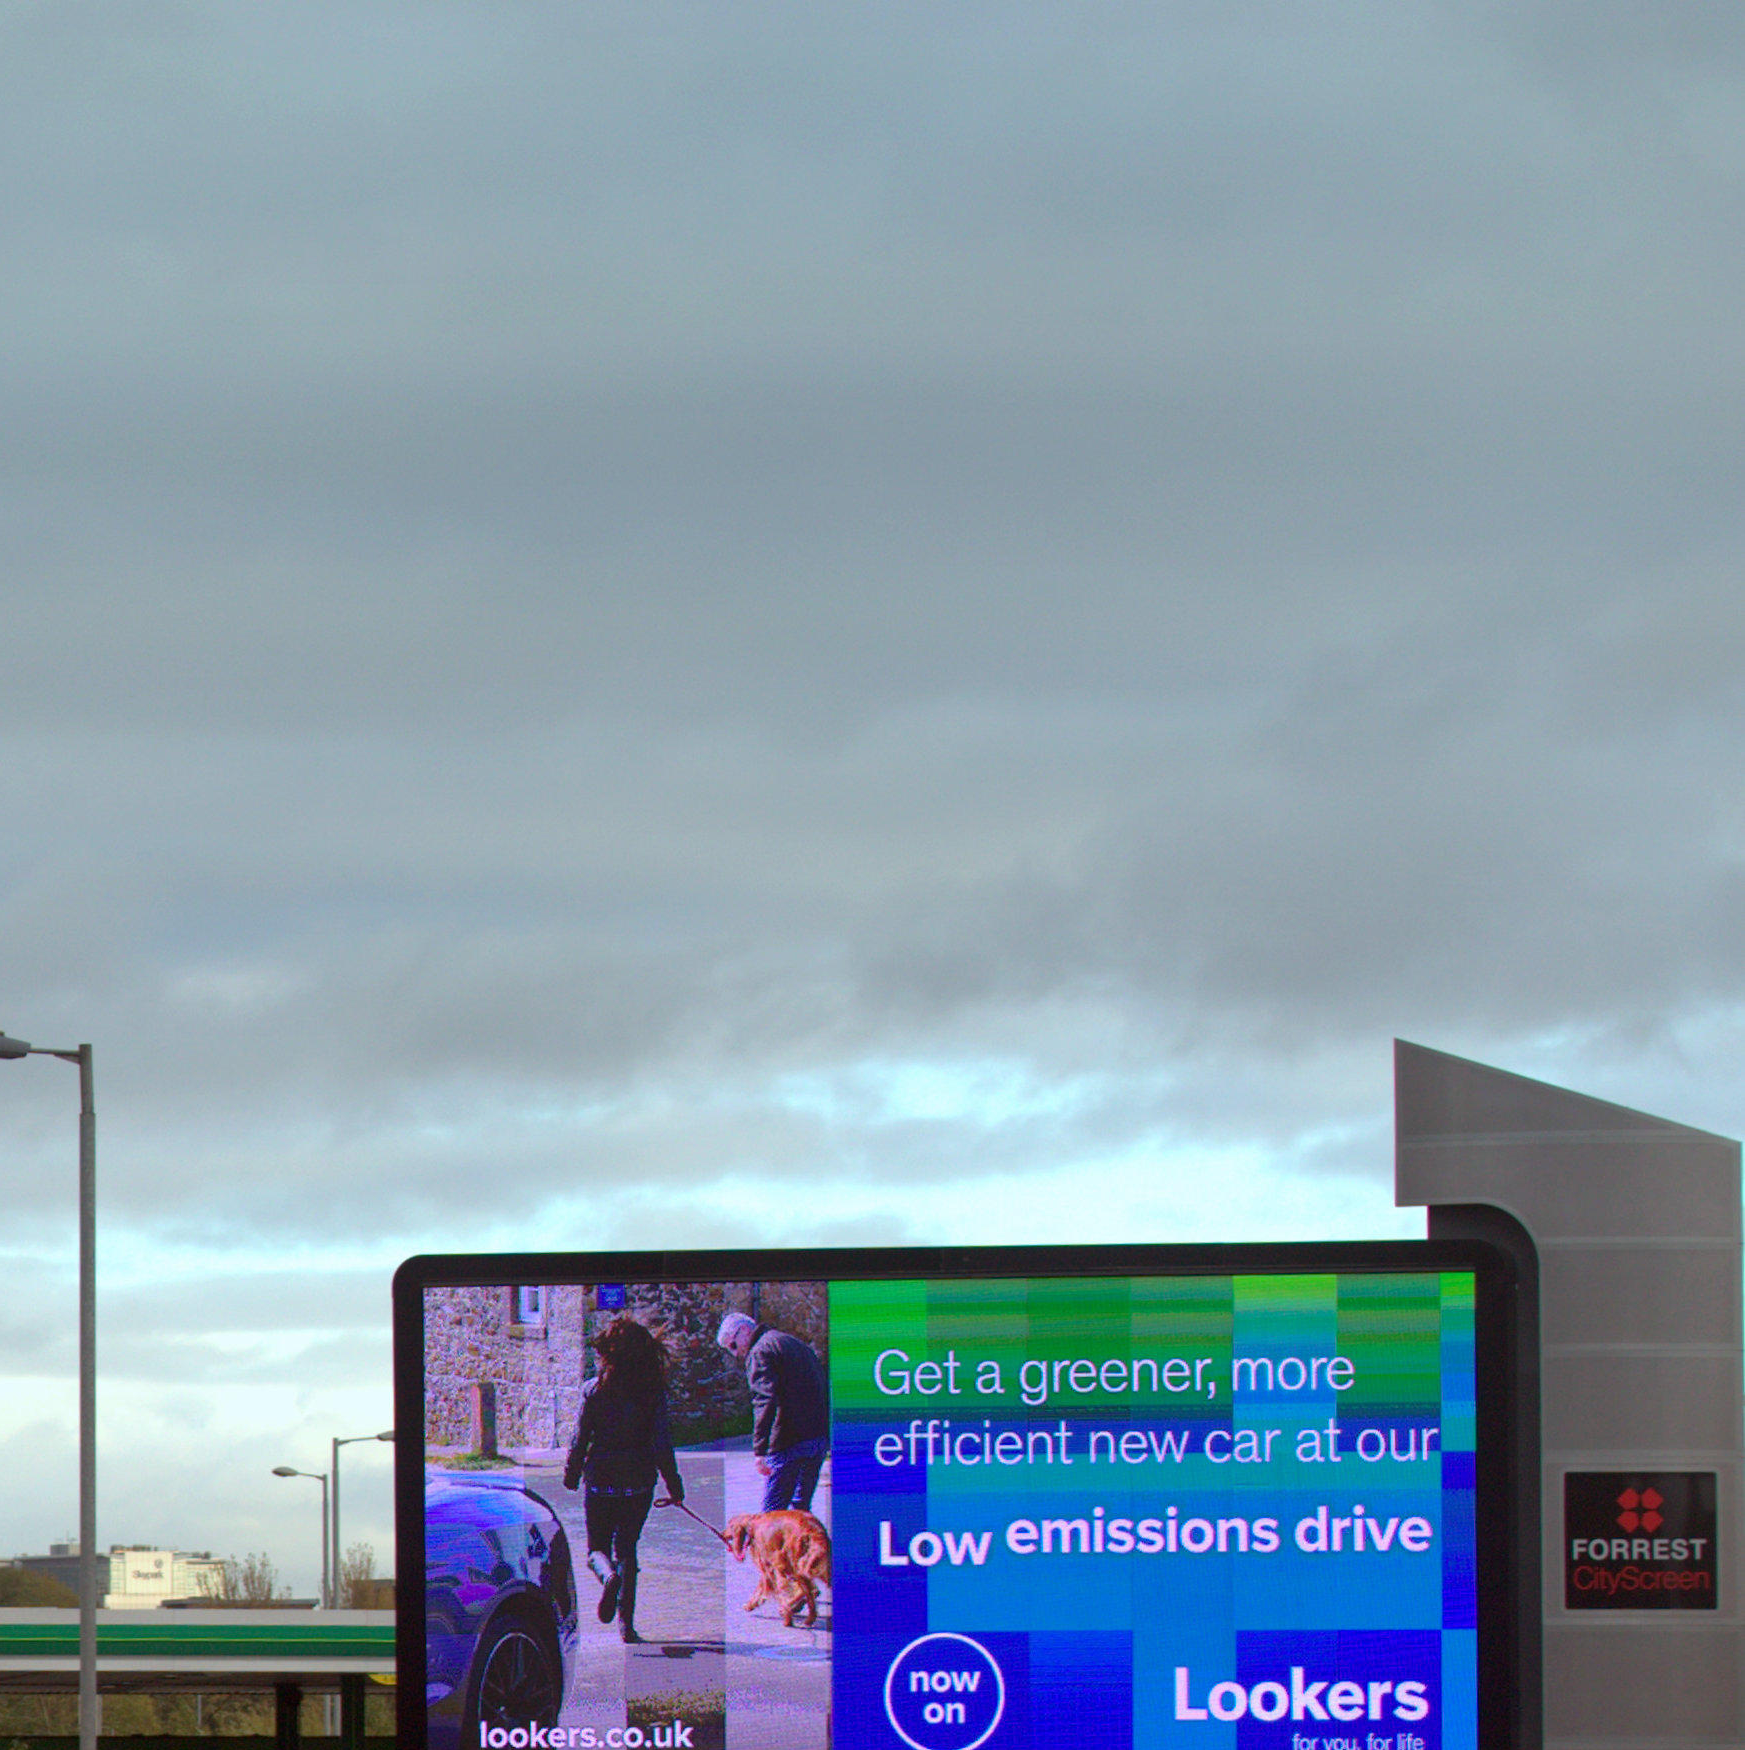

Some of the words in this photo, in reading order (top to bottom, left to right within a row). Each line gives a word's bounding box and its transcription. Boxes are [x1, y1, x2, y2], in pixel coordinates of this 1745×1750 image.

[873, 1348, 961, 1395] Get
[975, 1359, 1005, 1394] a
[1020, 1355, 1216, 1405] greener,
[1232, 1354, 1355, 1392] more
[873, 1418, 1073, 1467] efficient
[1088, 1429, 1188, 1465] new
[1204, 1426, 1281, 1463] car
[1294, 1418, 1343, 1463] at
[1355, 1424, 1439, 1463] our
[878, 1520, 992, 1567] Low
[1006, 1505, 1280, 1555] emissions
[1293, 1503, 1433, 1554] drive
[1571, 1538, 1707, 1561] FORREST
[1572, 1565, 1711, 1596] CityScreen
[909, 1669, 982, 1694] now
[1173, 1666, 1430, 1722] Lookers
[923, 1700, 967, 1725] on
[479, 1719, 695, 1749] lookers.co.uk
